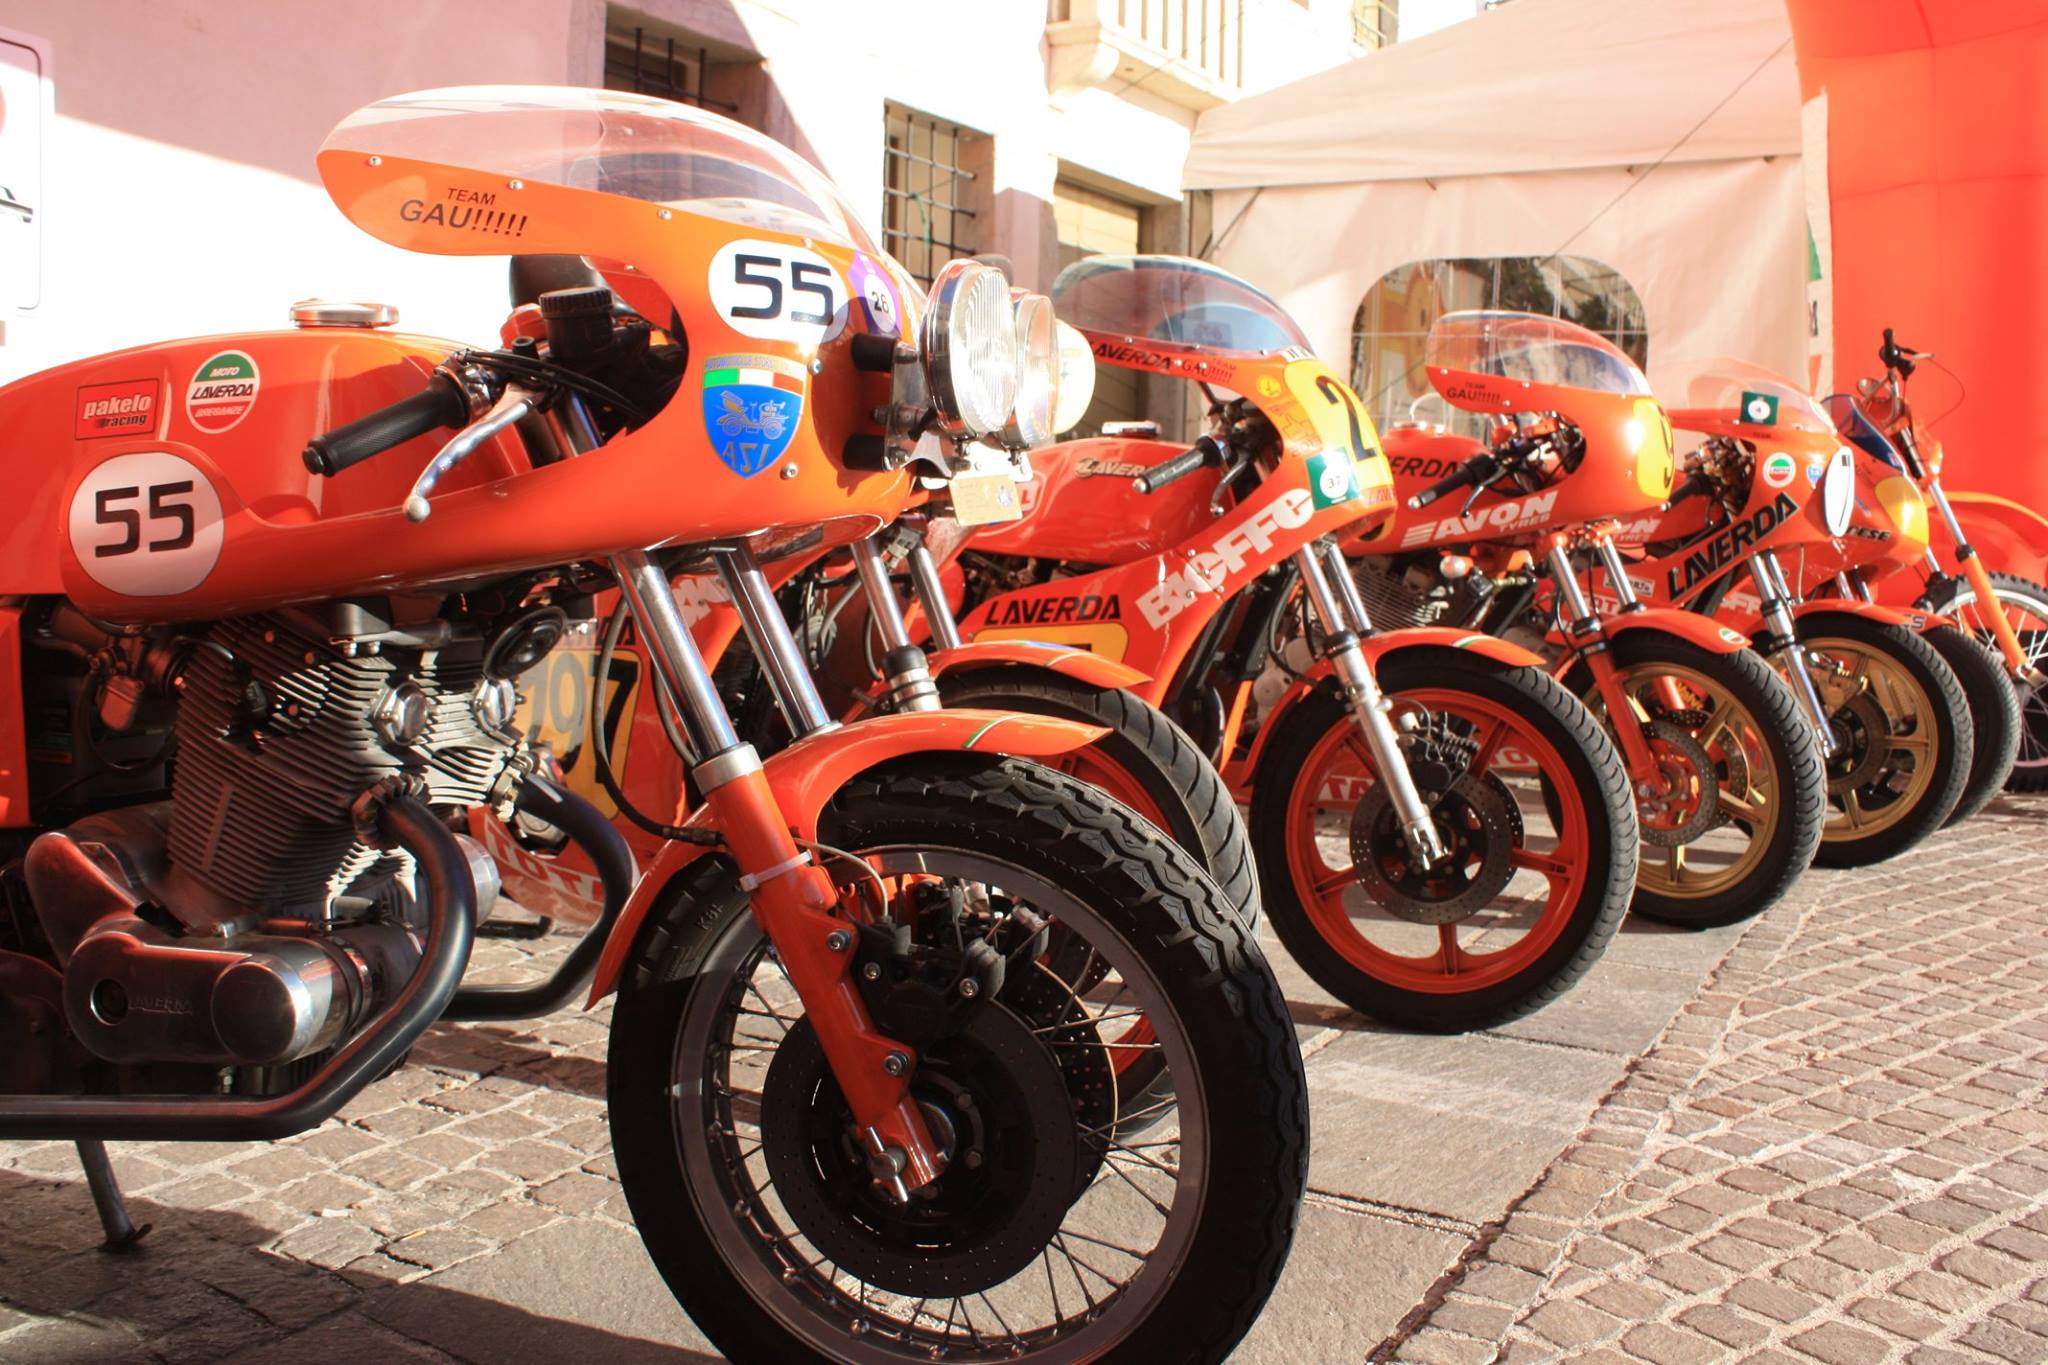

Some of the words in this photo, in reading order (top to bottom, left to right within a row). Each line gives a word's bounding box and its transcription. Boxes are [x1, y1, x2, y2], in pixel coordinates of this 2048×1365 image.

[448, 188, 496, 206] TEAM
[400, 199, 528, 237] GAU!!!!!
[731, 253, 834, 327] 55
[872, 290, 890, 314] 26
[208, 366, 241, 378] MOTO
[191, 383, 254, 401] LAVERDA
[83, 393, 152, 420] pakelo
[1315, 375, 1377, 462] 2
[103, 414, 147, 428] racing
[1075, 456, 1150, 478] LAVER
[1327, 474, 1342, 489] 37
[95, 479, 195, 559] 55
[1434, 491, 1559, 540] AVON
[1499, 511, 1551, 532] TYRES
[1668, 491, 1799, 600] LAVERDA
[984, 594, 1121, 626] LAVERDA
